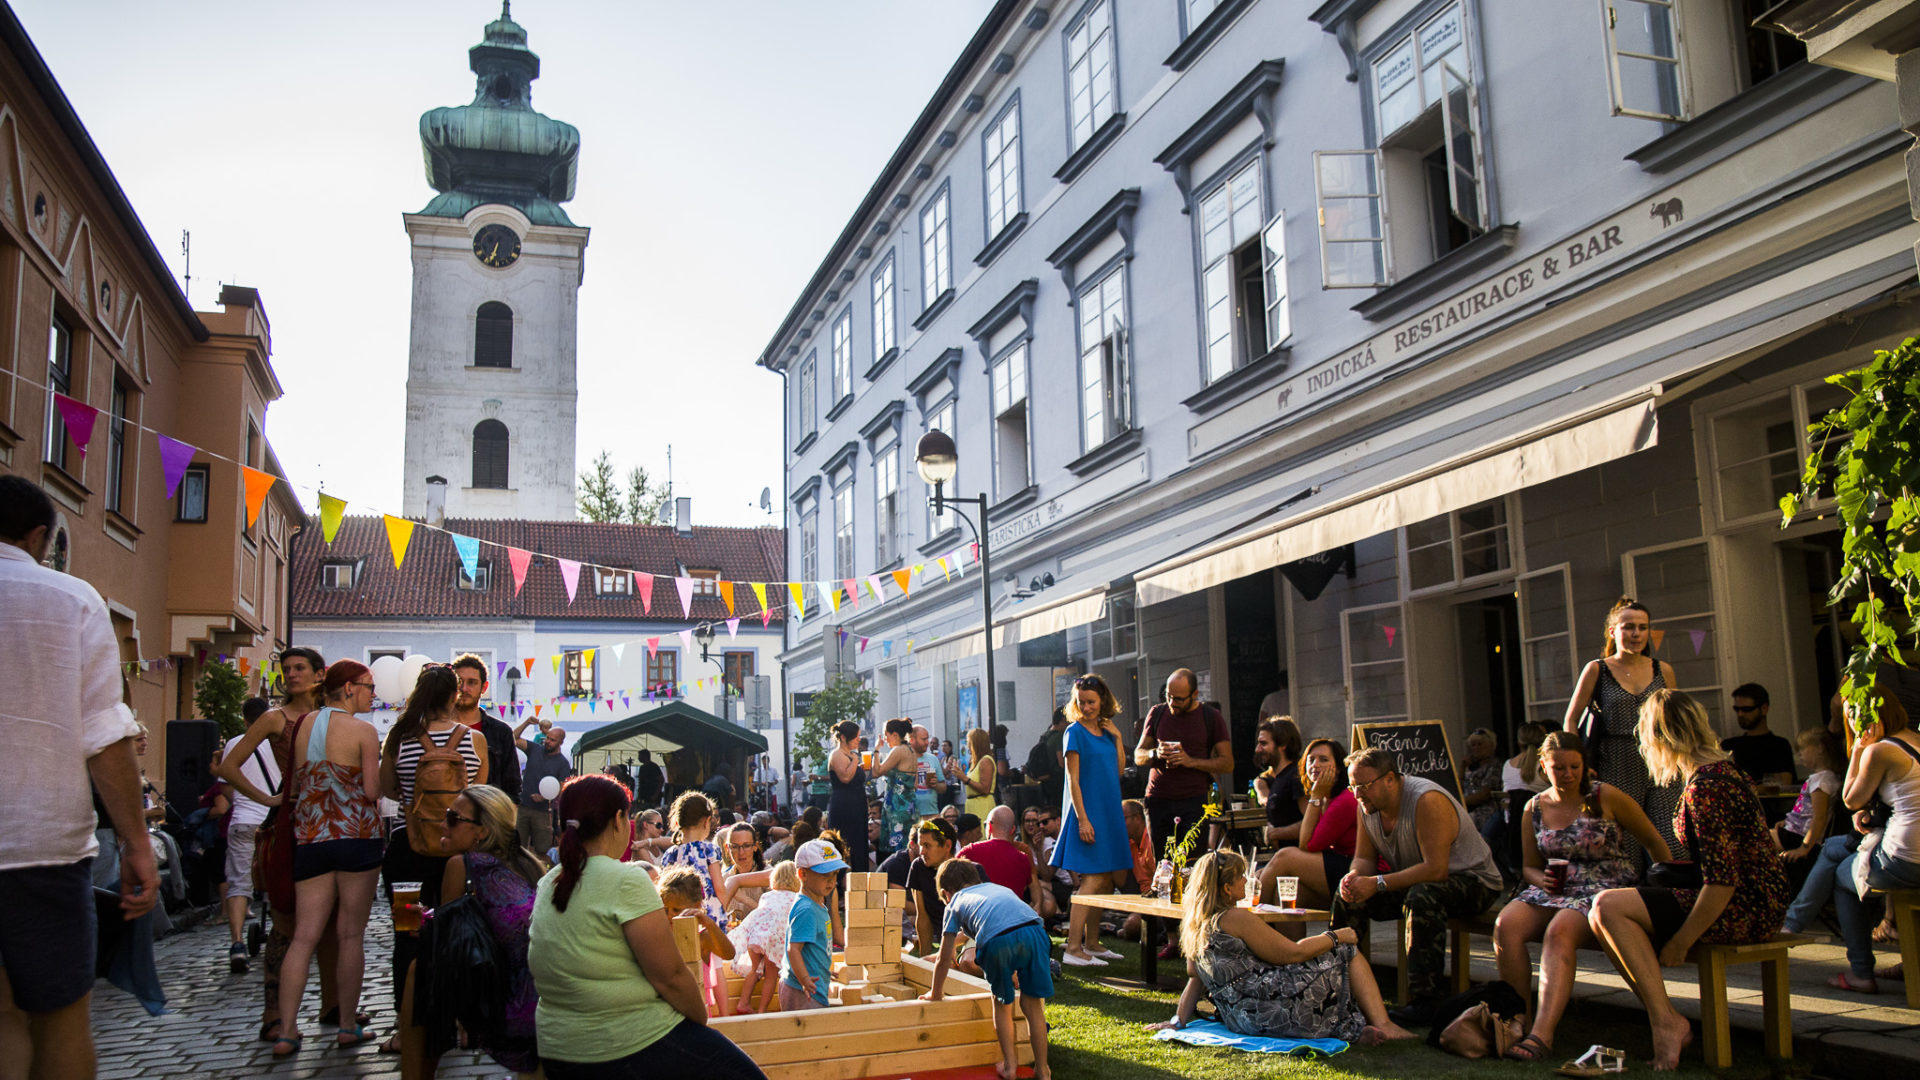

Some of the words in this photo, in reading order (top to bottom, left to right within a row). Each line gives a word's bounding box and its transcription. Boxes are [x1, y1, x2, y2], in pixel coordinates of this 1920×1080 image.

[1307, 342, 1376, 394] INDICKÁ
[1394, 268, 1534, 352] RESTAURACE
[1542, 257, 1560, 280] &
[1567, 225, 1623, 269] BAR
[1370, 729, 1429, 752] Točené
